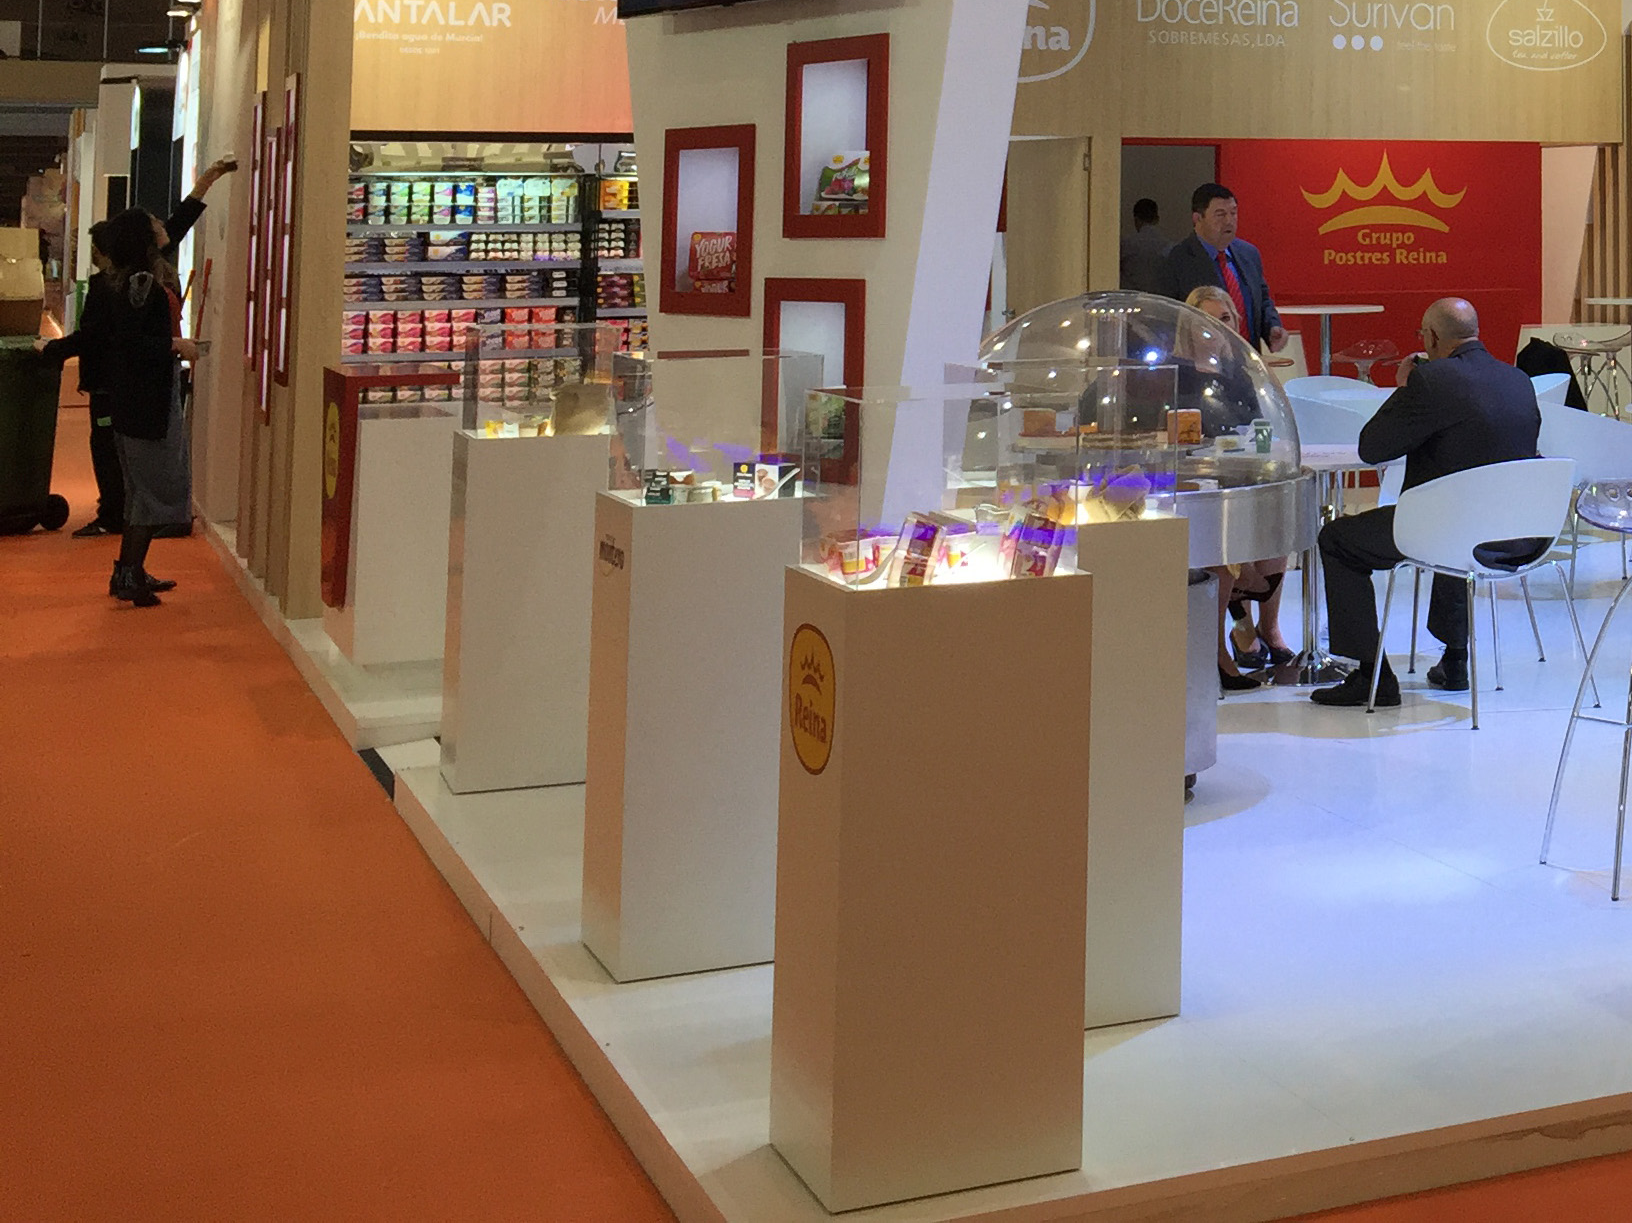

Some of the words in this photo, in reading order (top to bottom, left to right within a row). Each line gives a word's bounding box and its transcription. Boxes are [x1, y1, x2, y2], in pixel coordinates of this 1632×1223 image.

[1508, 25, 1584, 48] salzillo
[695, 235, 732, 258] YOGUR
[1357, 229, 1415, 246] Grupo
[697, 250, 731, 272] FRESA
[1323, 249, 1390, 265] Postres
[1395, 247, 1448, 264] Reina
[794, 693, 827, 744] Reina
